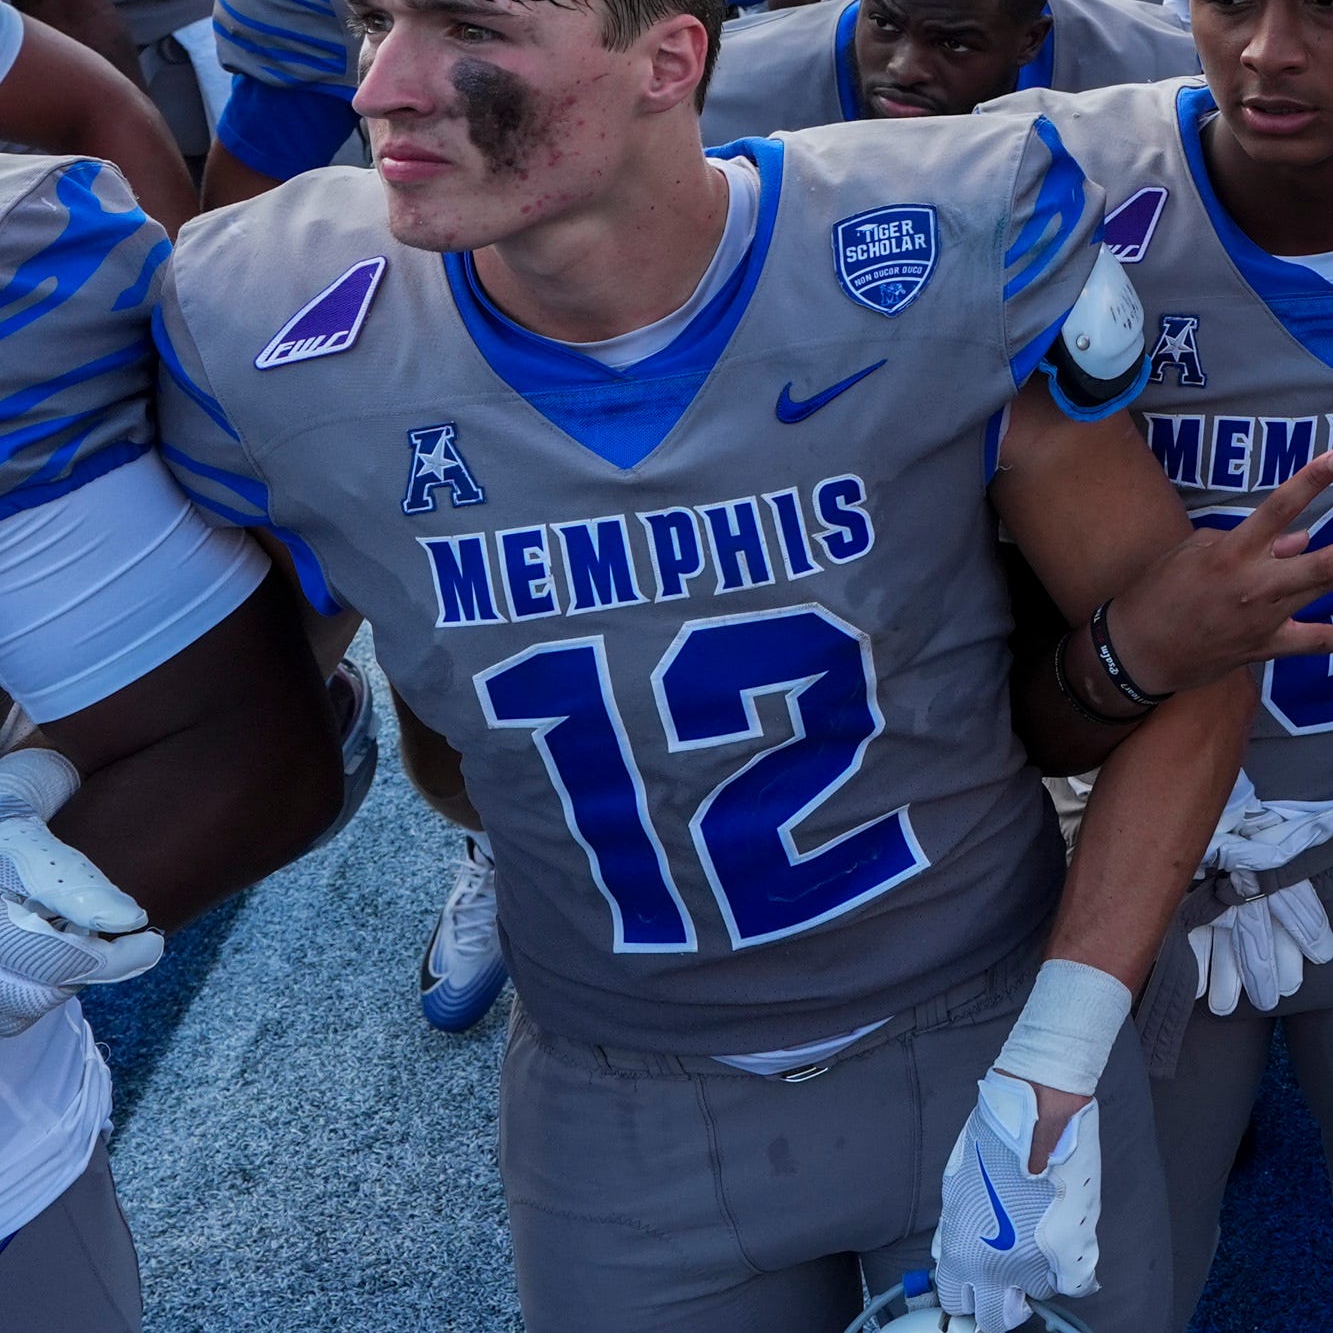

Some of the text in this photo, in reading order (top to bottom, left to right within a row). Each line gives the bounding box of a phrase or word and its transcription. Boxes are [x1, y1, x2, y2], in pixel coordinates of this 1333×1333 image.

[864, 219, 914, 243] TIGER
[845, 233, 927, 263] SCHOLAR
[854, 265, 923, 287] NON DUCOR DUCO
[415, 471, 876, 629] MEMPHIS
[472, 602, 930, 954] 12
